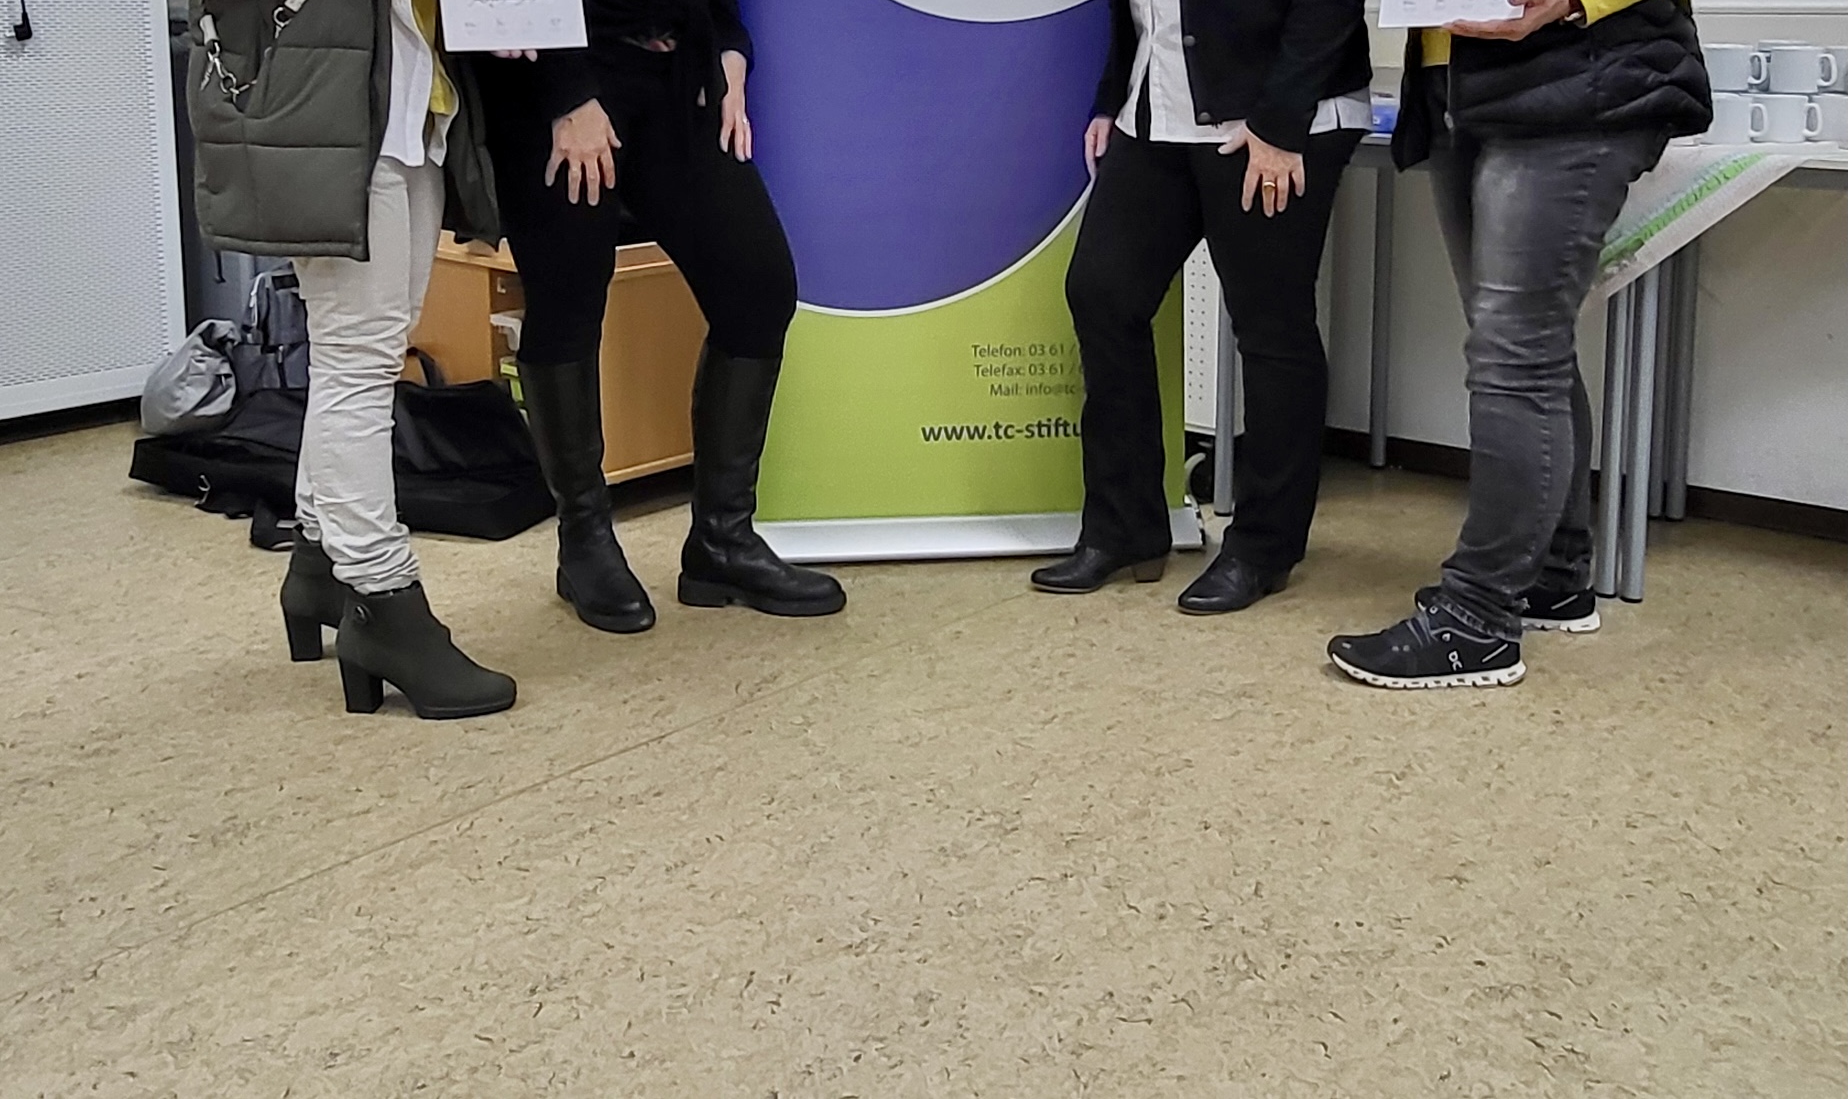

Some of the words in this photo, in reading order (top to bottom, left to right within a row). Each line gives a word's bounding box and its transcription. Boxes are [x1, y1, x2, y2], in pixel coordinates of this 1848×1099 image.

[971, 344, 1024, 359] Telefon:
[1028, 344, 1045, 356] 03
[1049, 343, 1064, 356] 61
[974, 364, 1025, 377] Telefax:
[1028, 364, 1045, 376] 03
[1049, 363, 1064, 375] 61
[990, 384, 1022, 397] Mail:
